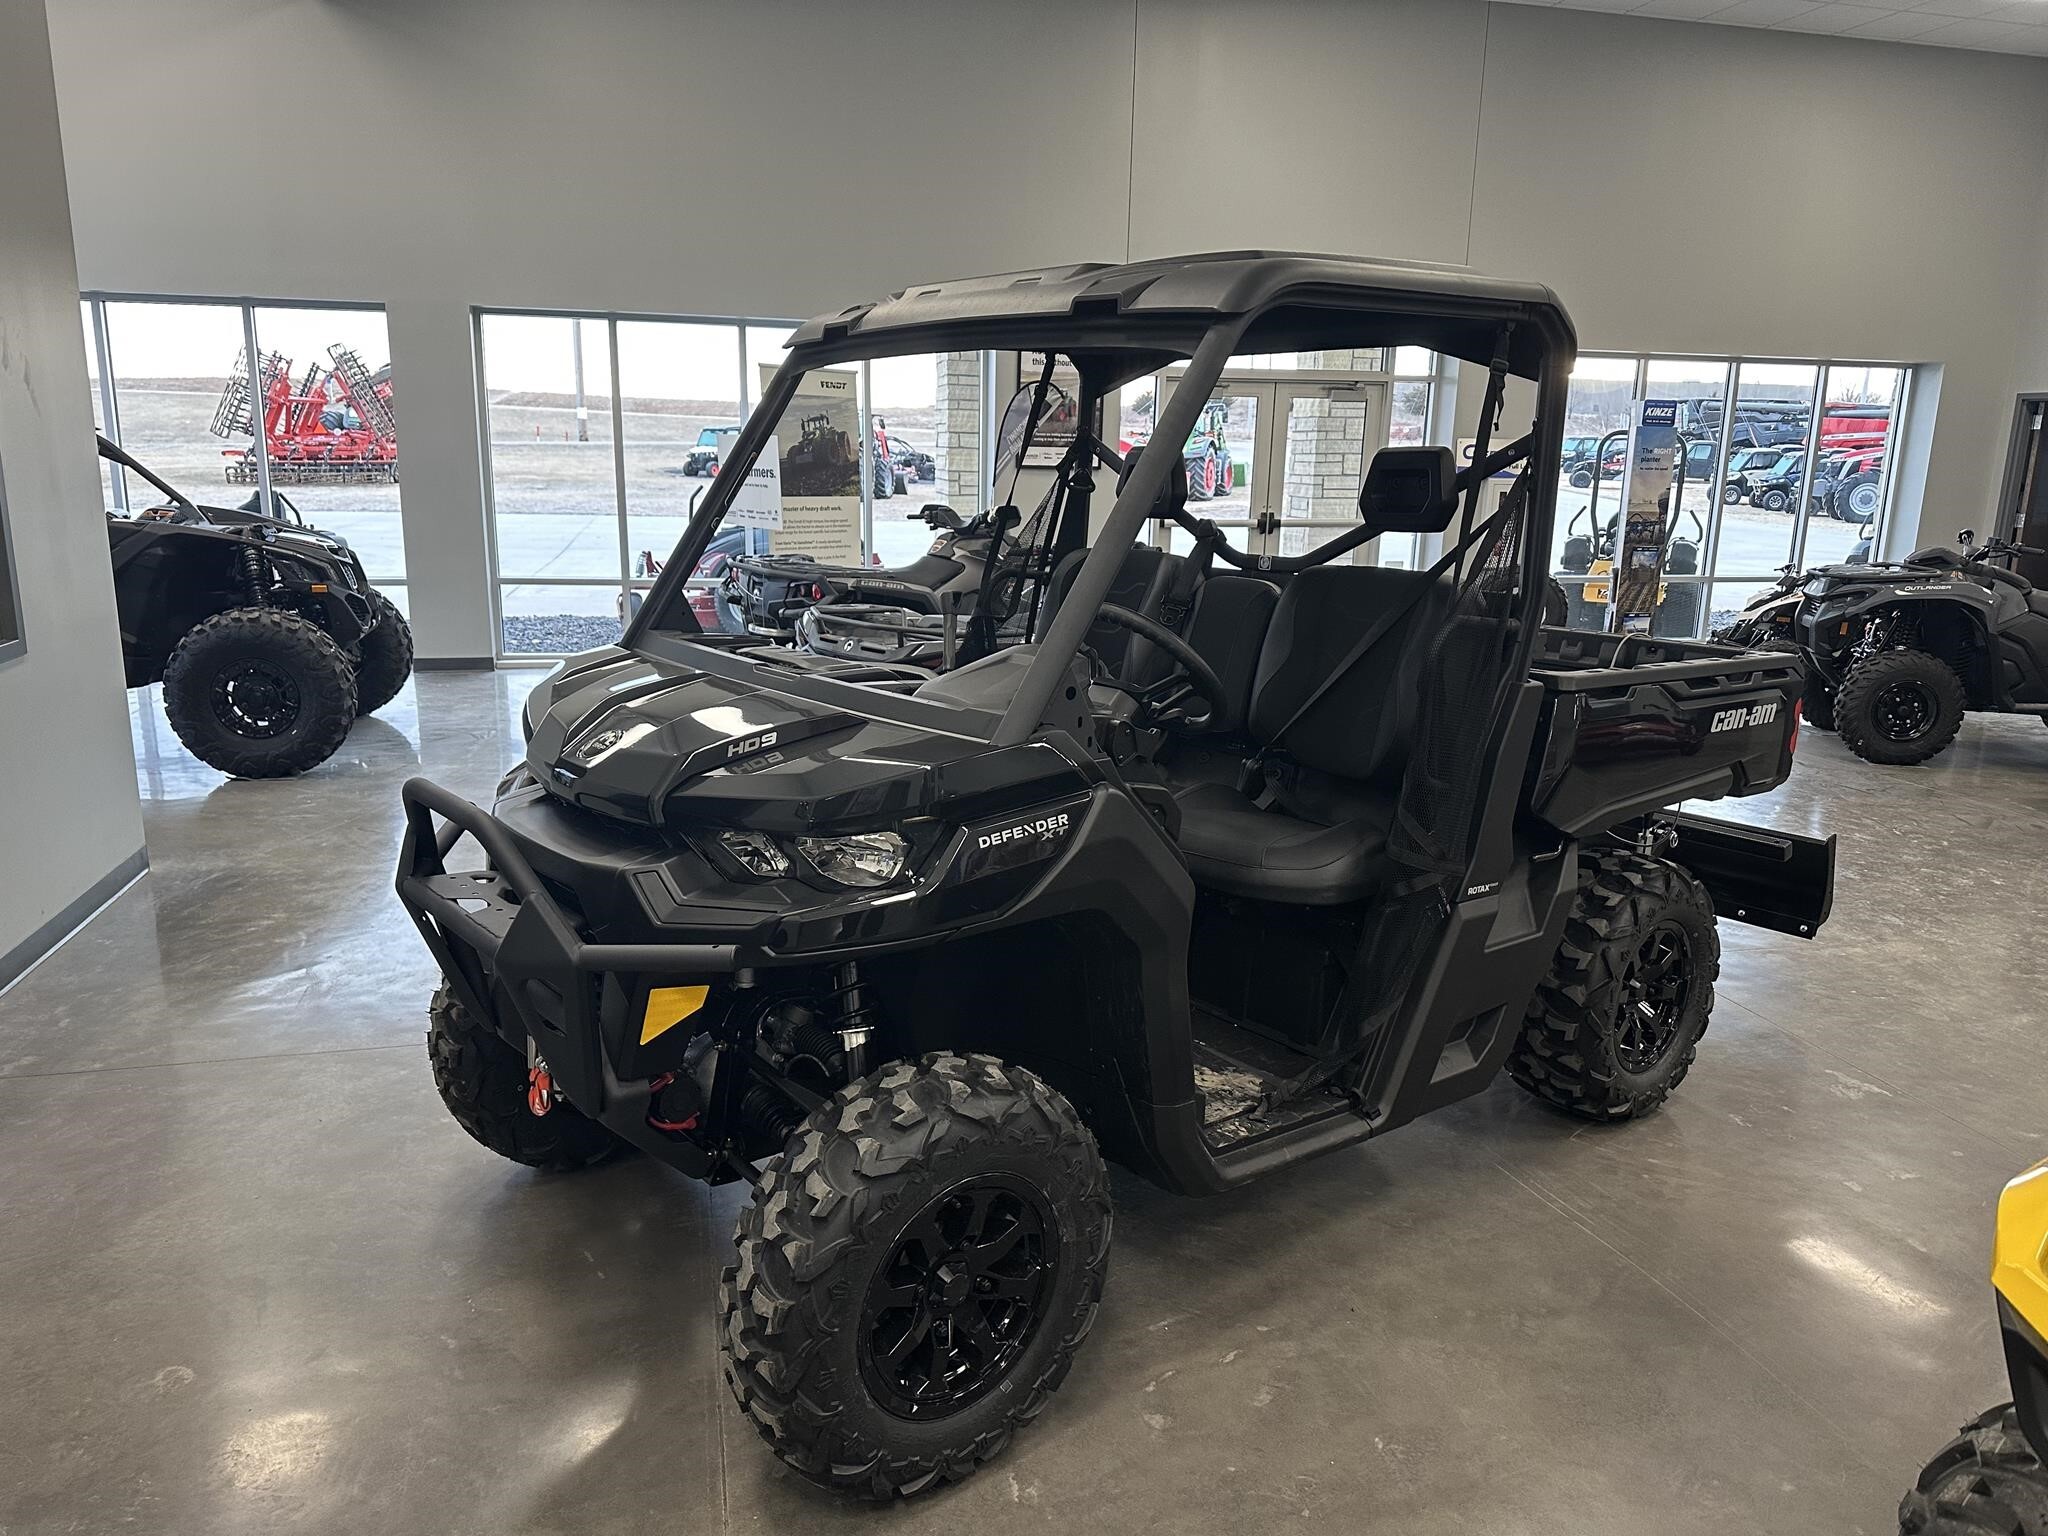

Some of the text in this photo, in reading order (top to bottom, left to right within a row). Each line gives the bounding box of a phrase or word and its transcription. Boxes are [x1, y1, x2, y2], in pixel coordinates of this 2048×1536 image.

[1032, 358, 1045, 366] this
[820, 380, 847, 390] FENDT
[1645, 407, 1675, 417] KINZE
[1642, 447, 1673, 455] The RIGHT
[805, 505, 819, 513] heavy
[860, 580, 905, 590] can-am
[1710, 702, 1777, 733] can-am
[727, 731, 778, 758] HD9
[978, 813, 1069, 849] DEFENDER
[1041, 825, 1069, 841] XT
[1467, 884, 1490, 896] ROTAX
